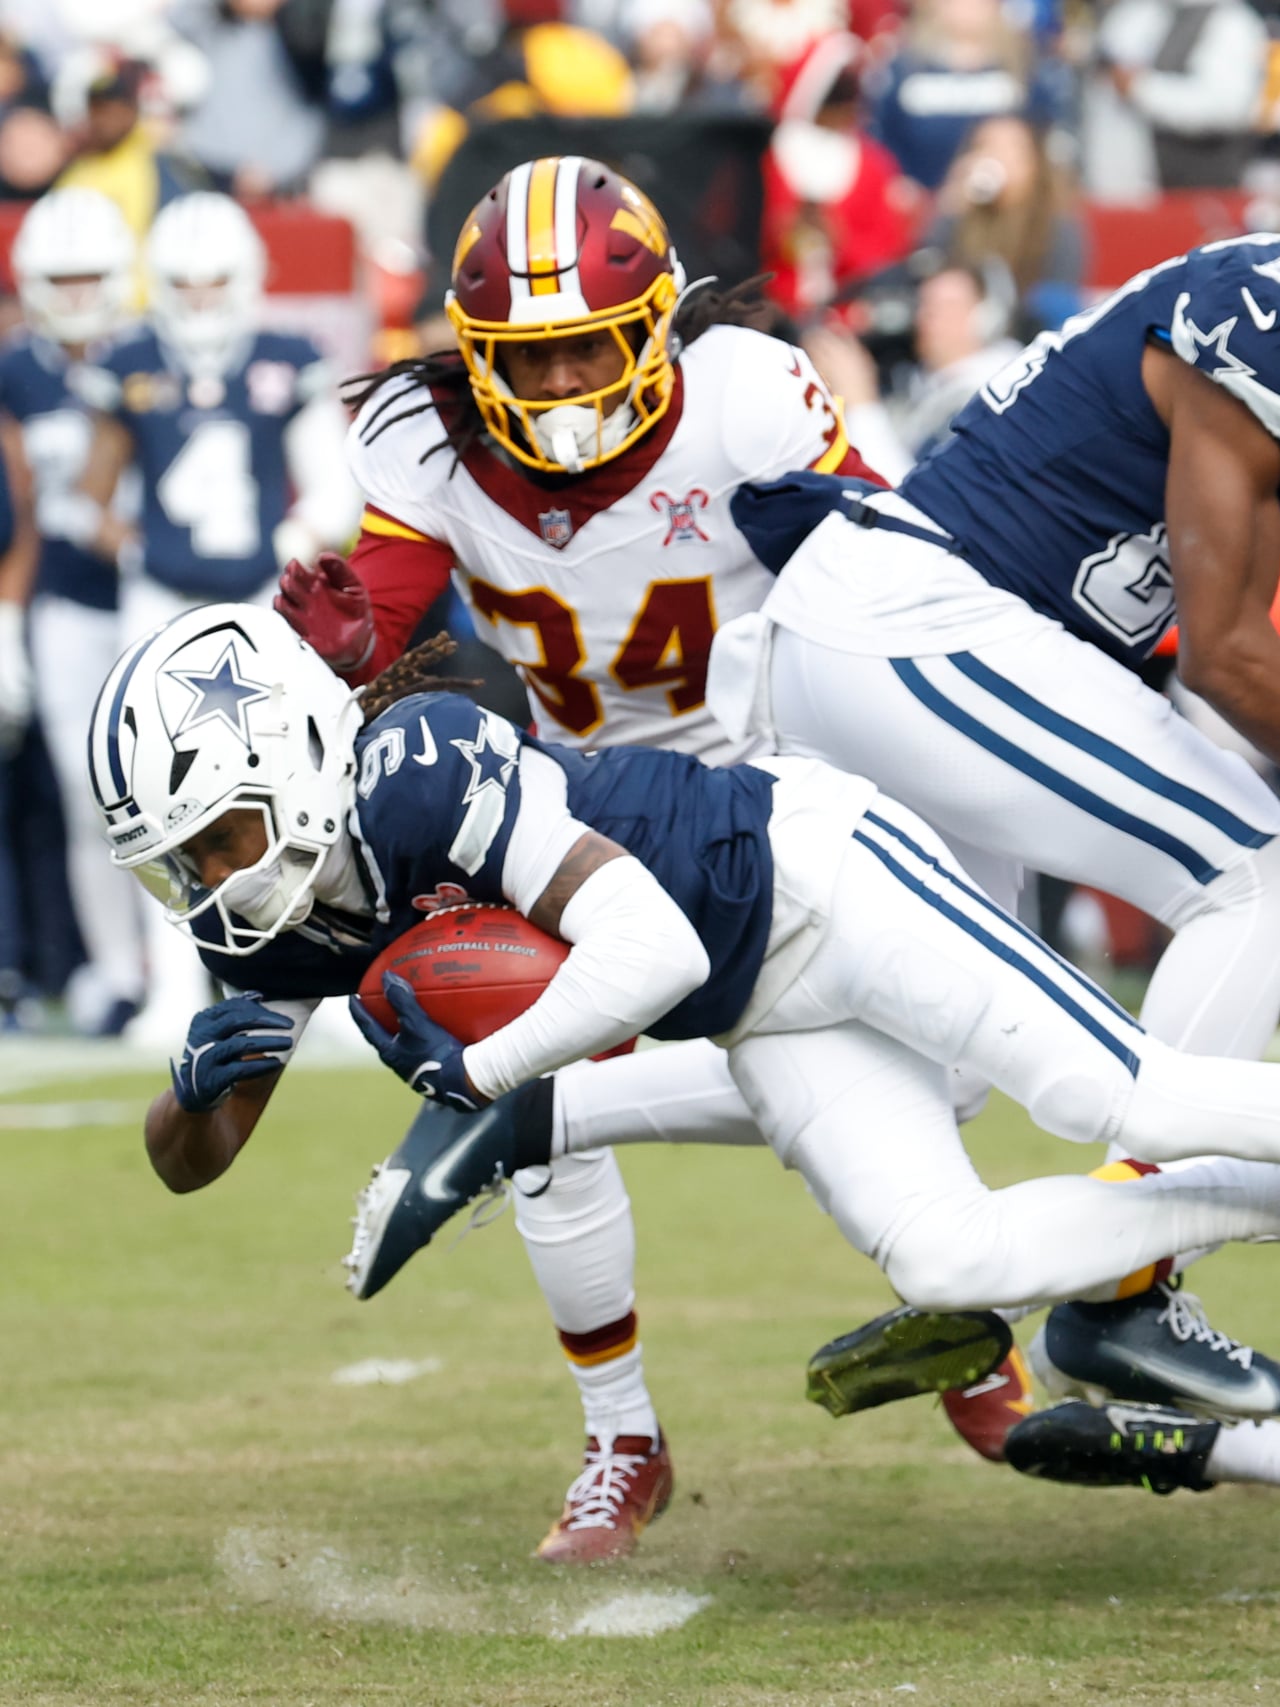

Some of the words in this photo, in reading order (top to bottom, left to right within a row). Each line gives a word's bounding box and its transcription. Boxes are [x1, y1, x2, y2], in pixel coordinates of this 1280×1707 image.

[156, 420, 260, 558] 4
[468, 573, 718, 738] 34
[358, 727, 406, 800] 9
[437, 942, 490, 953] FOOTBALL
[494, 943, 538, 957] LEAGUE
